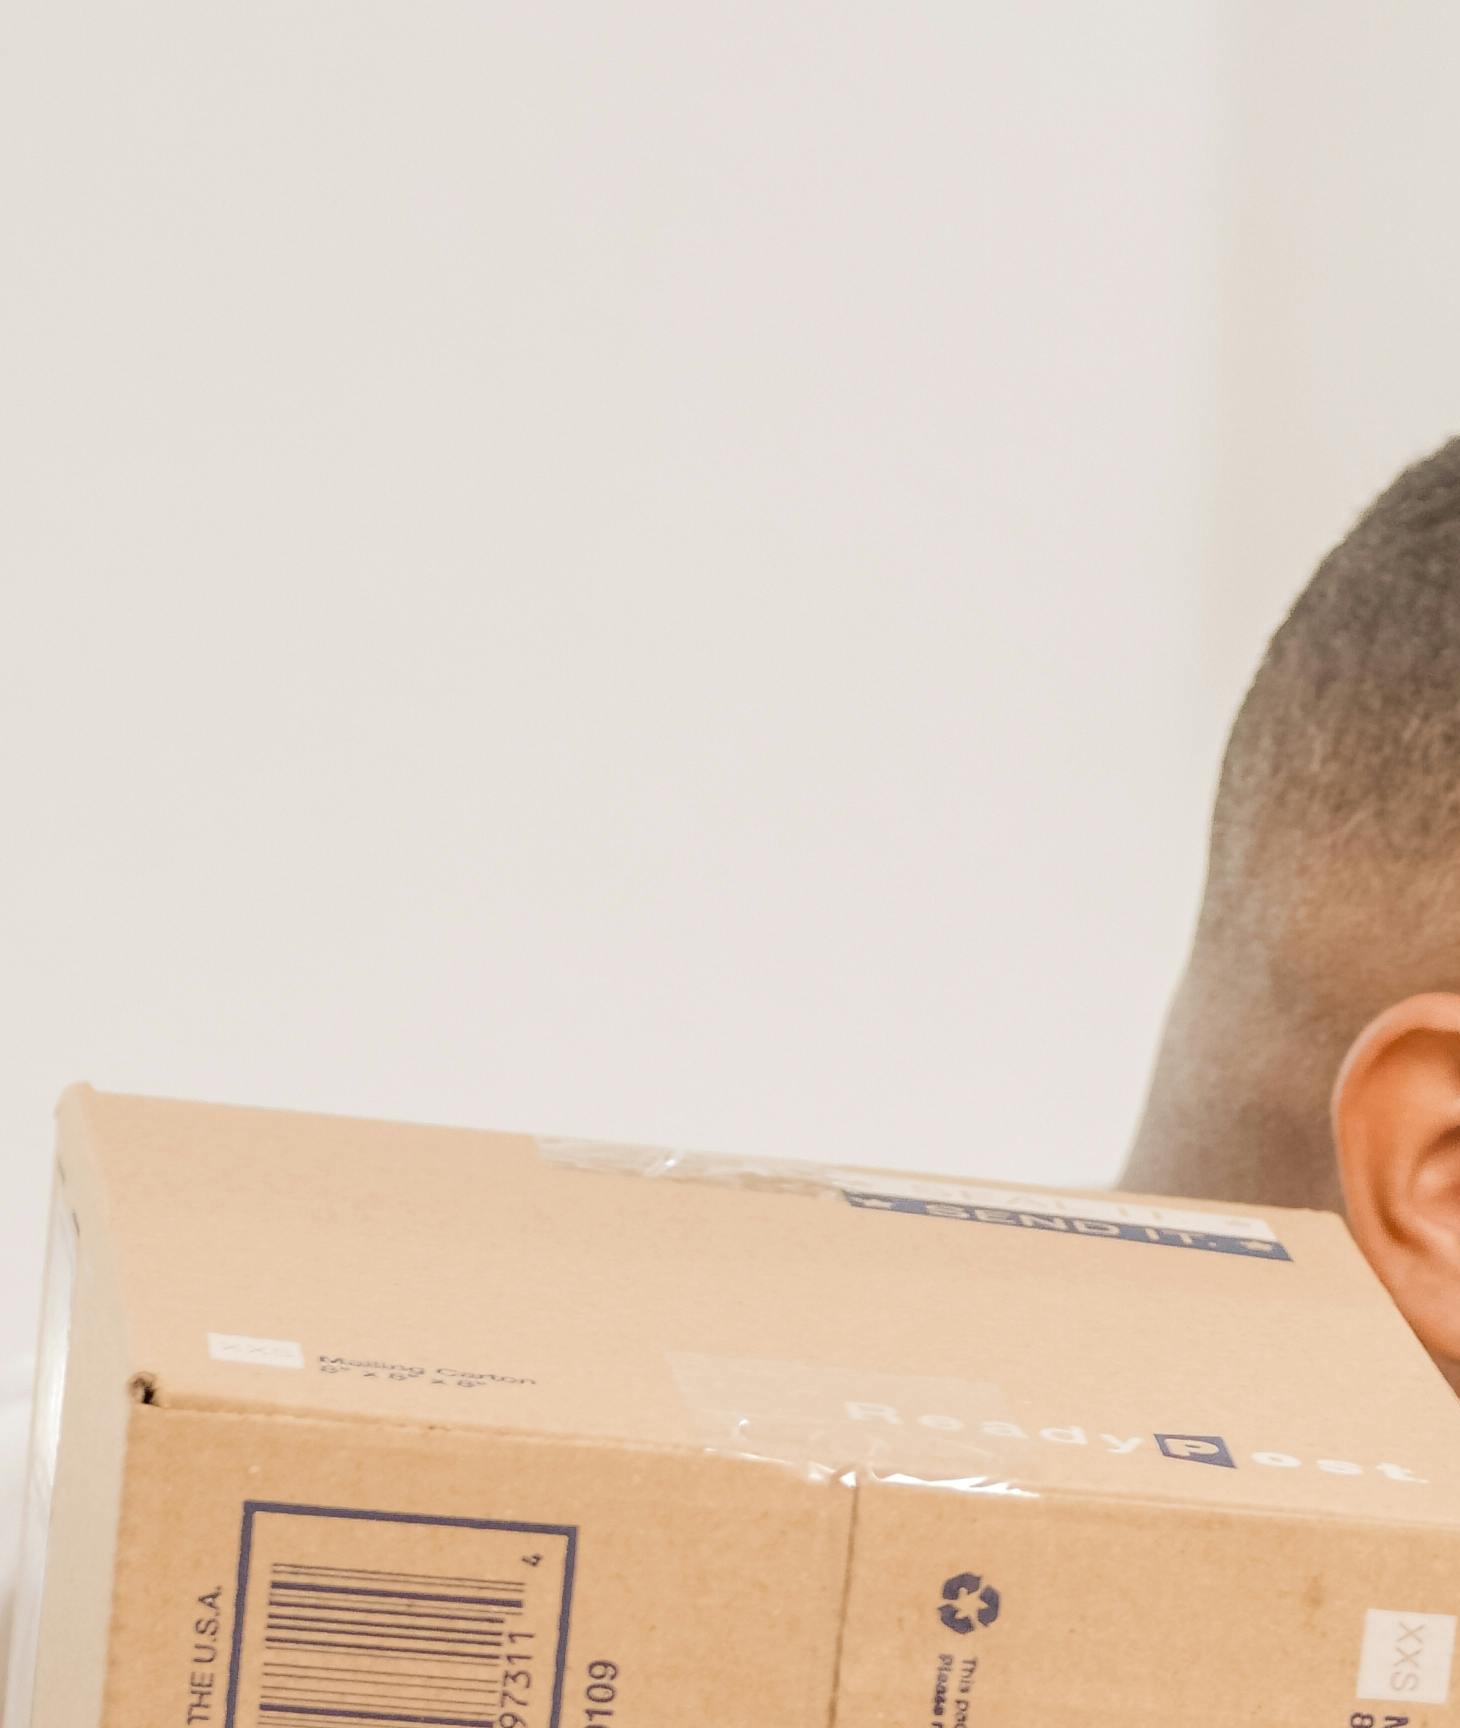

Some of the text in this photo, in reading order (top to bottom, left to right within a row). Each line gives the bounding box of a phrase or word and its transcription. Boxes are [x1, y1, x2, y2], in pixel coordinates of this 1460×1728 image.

[926, 1204, 1119, 1236] SEND
[319, 1355, 537, 1386] Mailing Carton
[521, 1552, 542, 1568] 4
[193, 1586, 222, 1664] U.S.A.
[960, 1656, 978, 1694] This
[1389, 1622, 1425, 1693] XXS
[187, 1672, 214, 1726] THE
[933, 1653, 954, 1716] Please
